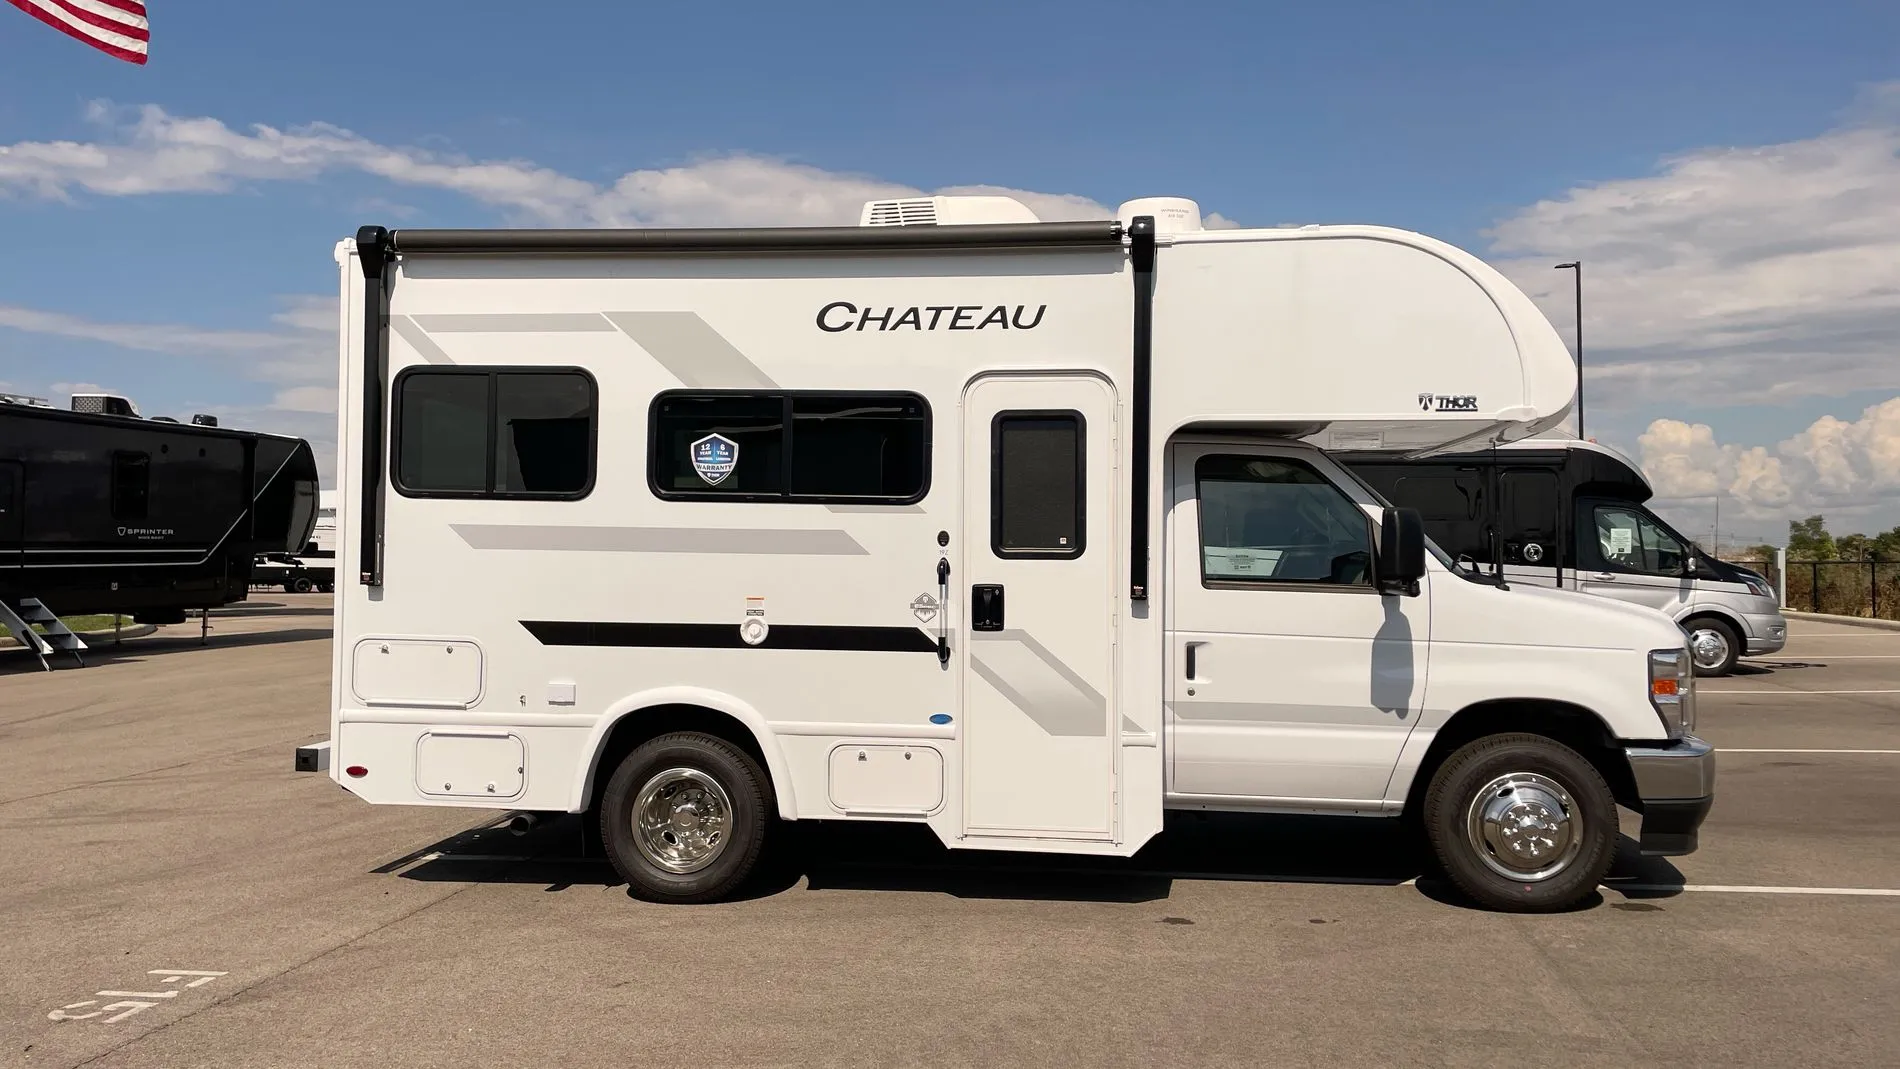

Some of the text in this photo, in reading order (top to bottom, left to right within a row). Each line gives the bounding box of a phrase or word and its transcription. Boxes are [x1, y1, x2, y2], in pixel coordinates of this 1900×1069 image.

[815, 300, 1047, 332] CHATEAU
[1435, 395, 1478, 409] THOR
[701, 443, 711, 451] 12
[720, 443, 726, 451] 6
